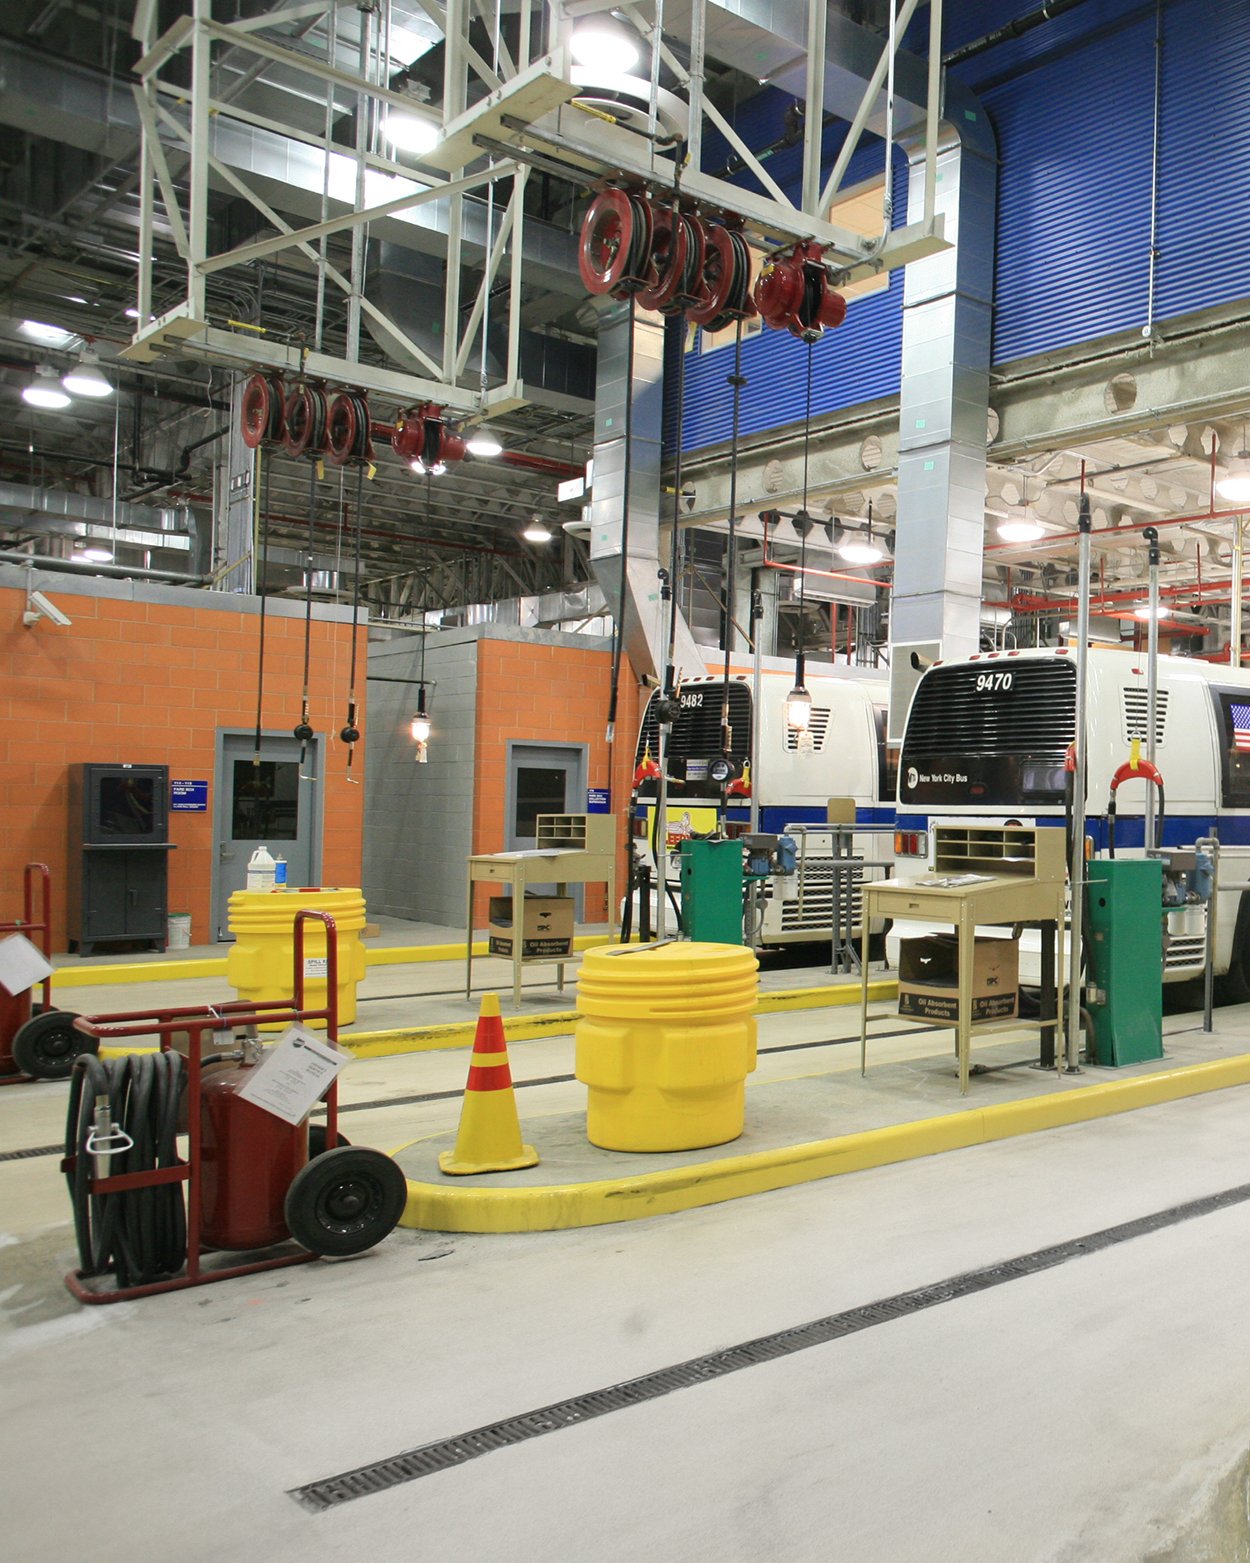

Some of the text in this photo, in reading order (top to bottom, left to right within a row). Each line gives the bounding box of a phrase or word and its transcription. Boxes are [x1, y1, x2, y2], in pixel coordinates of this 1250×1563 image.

[976, 673, 1013, 691] 9470
[680, 694, 704, 708] 9482
[919, 774, 931, 783] New
[931, 774, 943, 783] York
[943, 774, 955, 785] City
[955, 774, 968, 783] Bus
[918, 998, 957, 1009] Oil Absorbent
[980, 996, 1015, 1008] Oil Absorbent
[924, 1007, 950, 1017] Products
[985, 1006, 1009, 1015] Products
